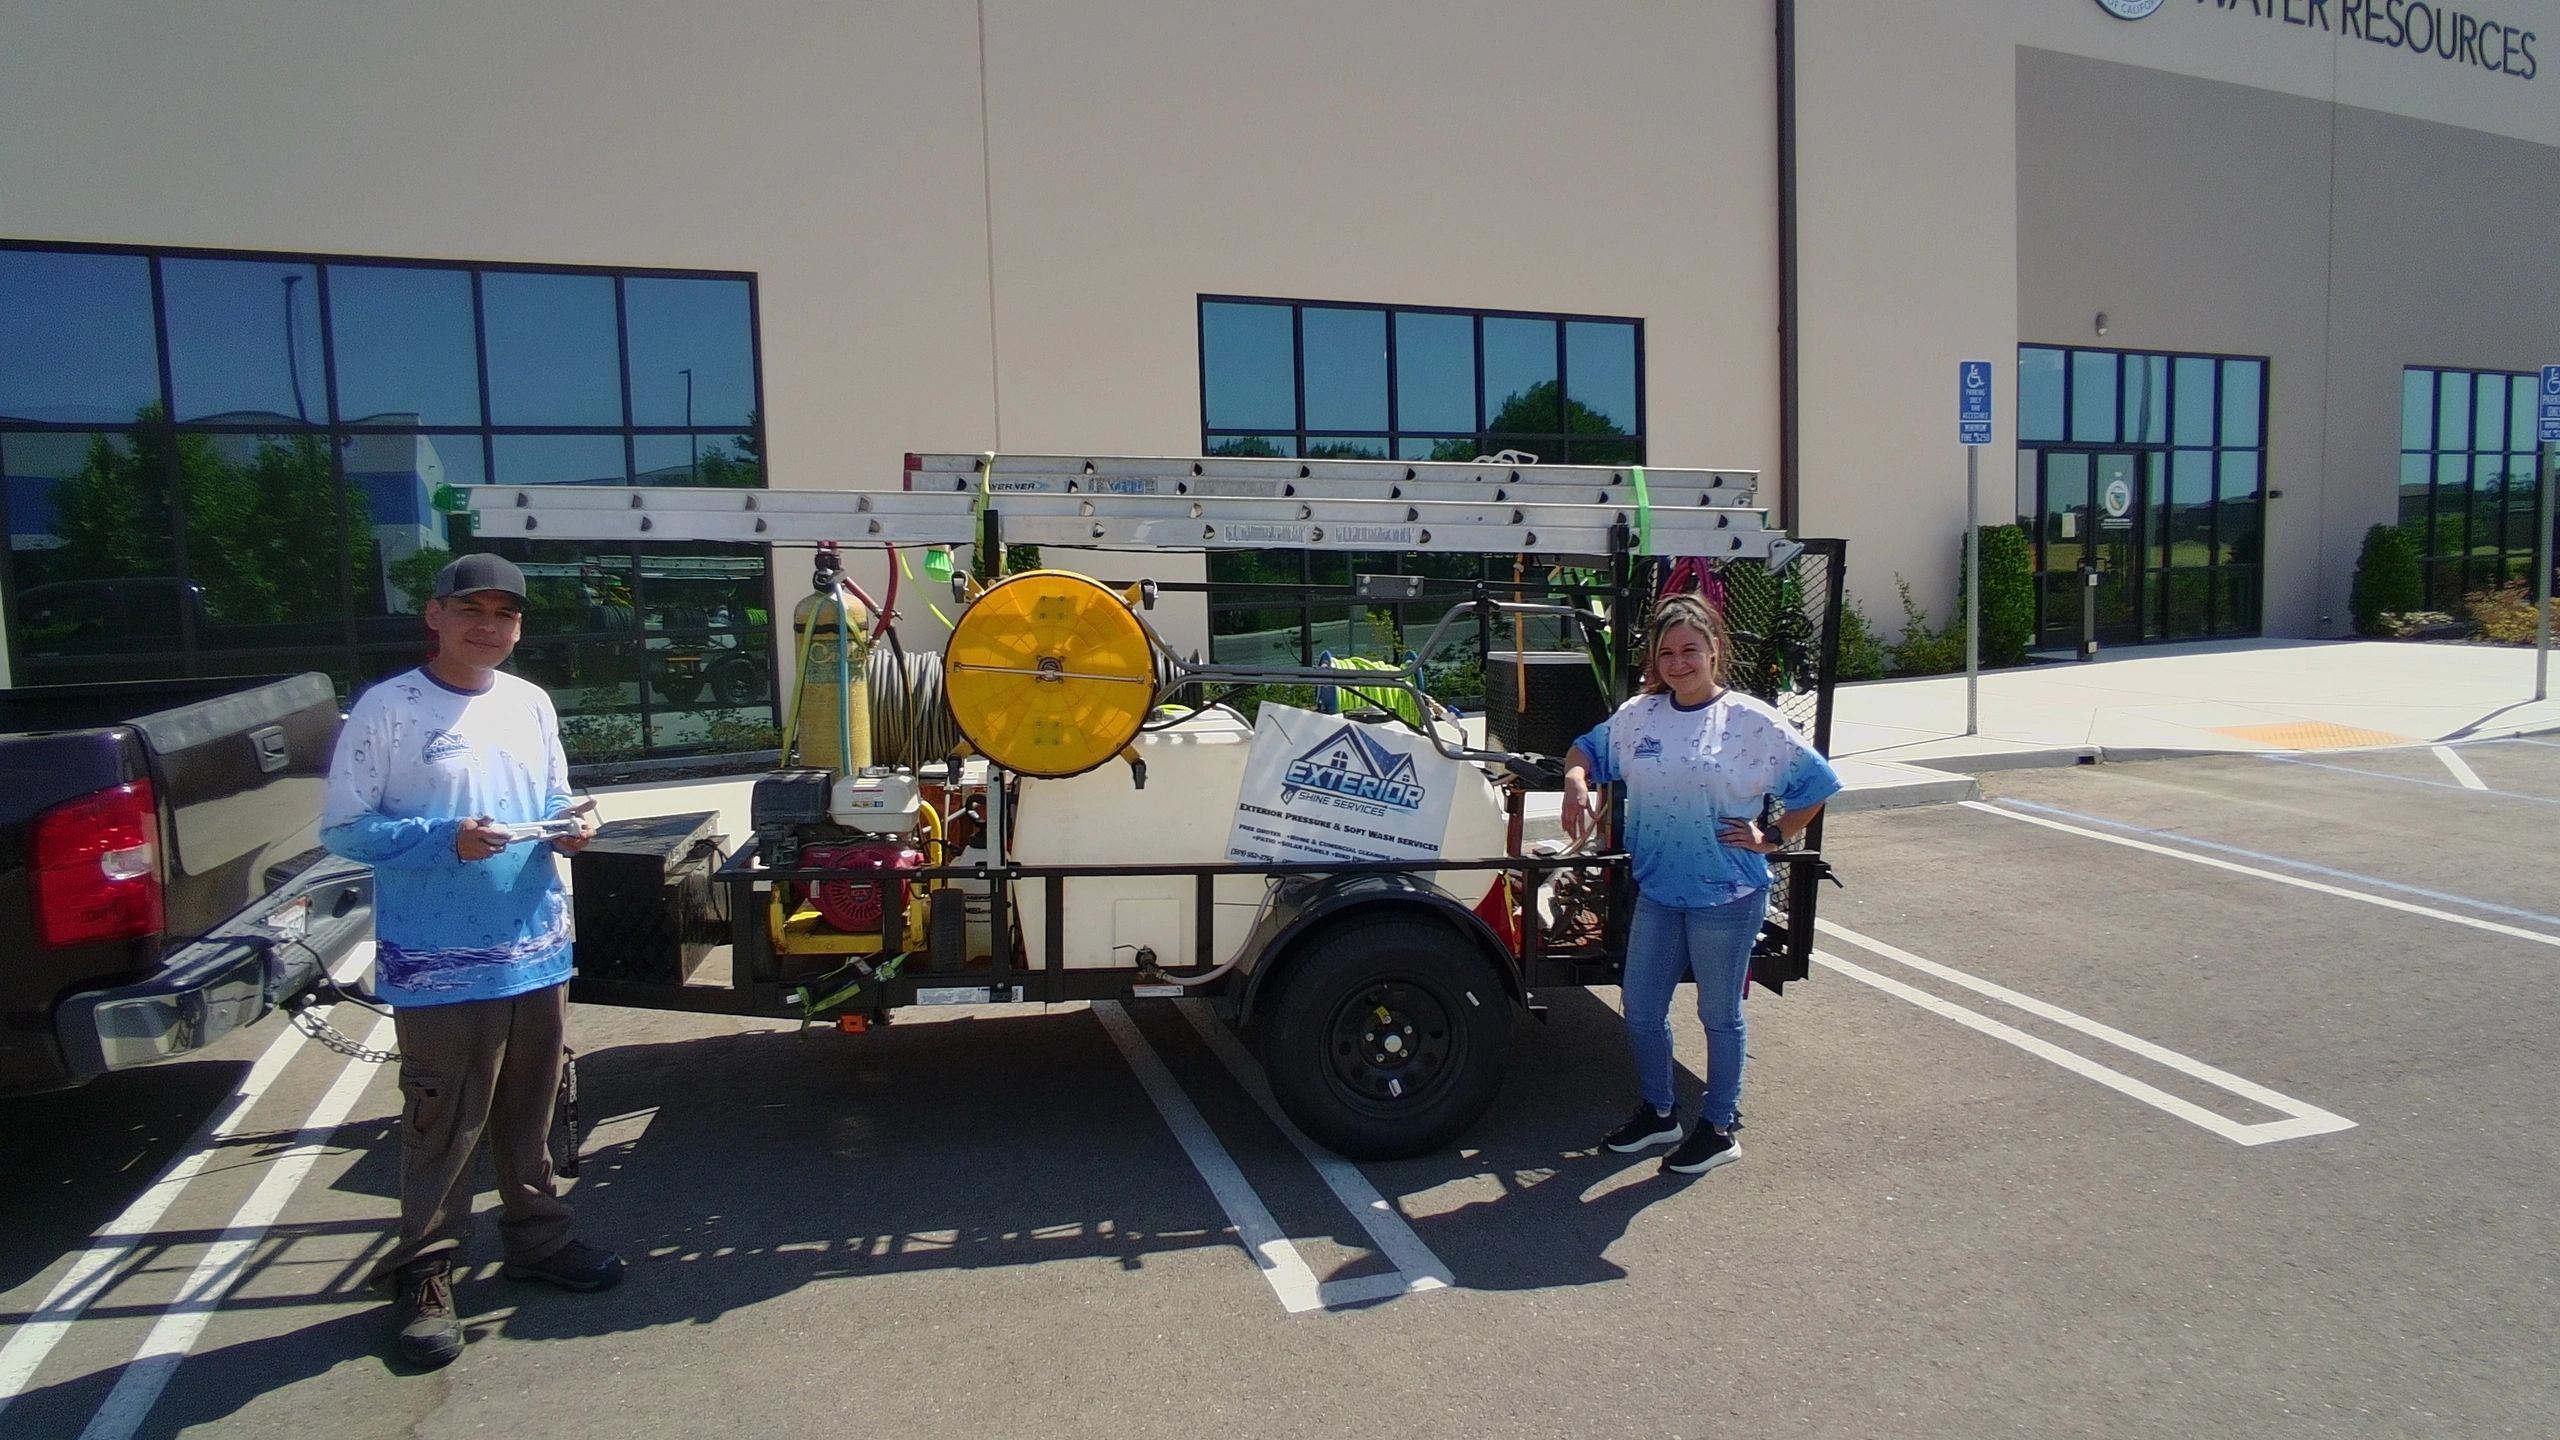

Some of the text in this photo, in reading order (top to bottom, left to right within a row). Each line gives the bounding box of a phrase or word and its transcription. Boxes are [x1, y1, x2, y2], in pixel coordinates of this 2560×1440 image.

[2341, 0, 2537, 80] RESOURCES
[1286, 759, 1424, 809] EXTERIOR
[1298, 791, 1385, 817] SHINE SERVICES
[1239, 802, 1439, 852] EXTERIOR PRESSURE & SOFT WASH SERVICES
